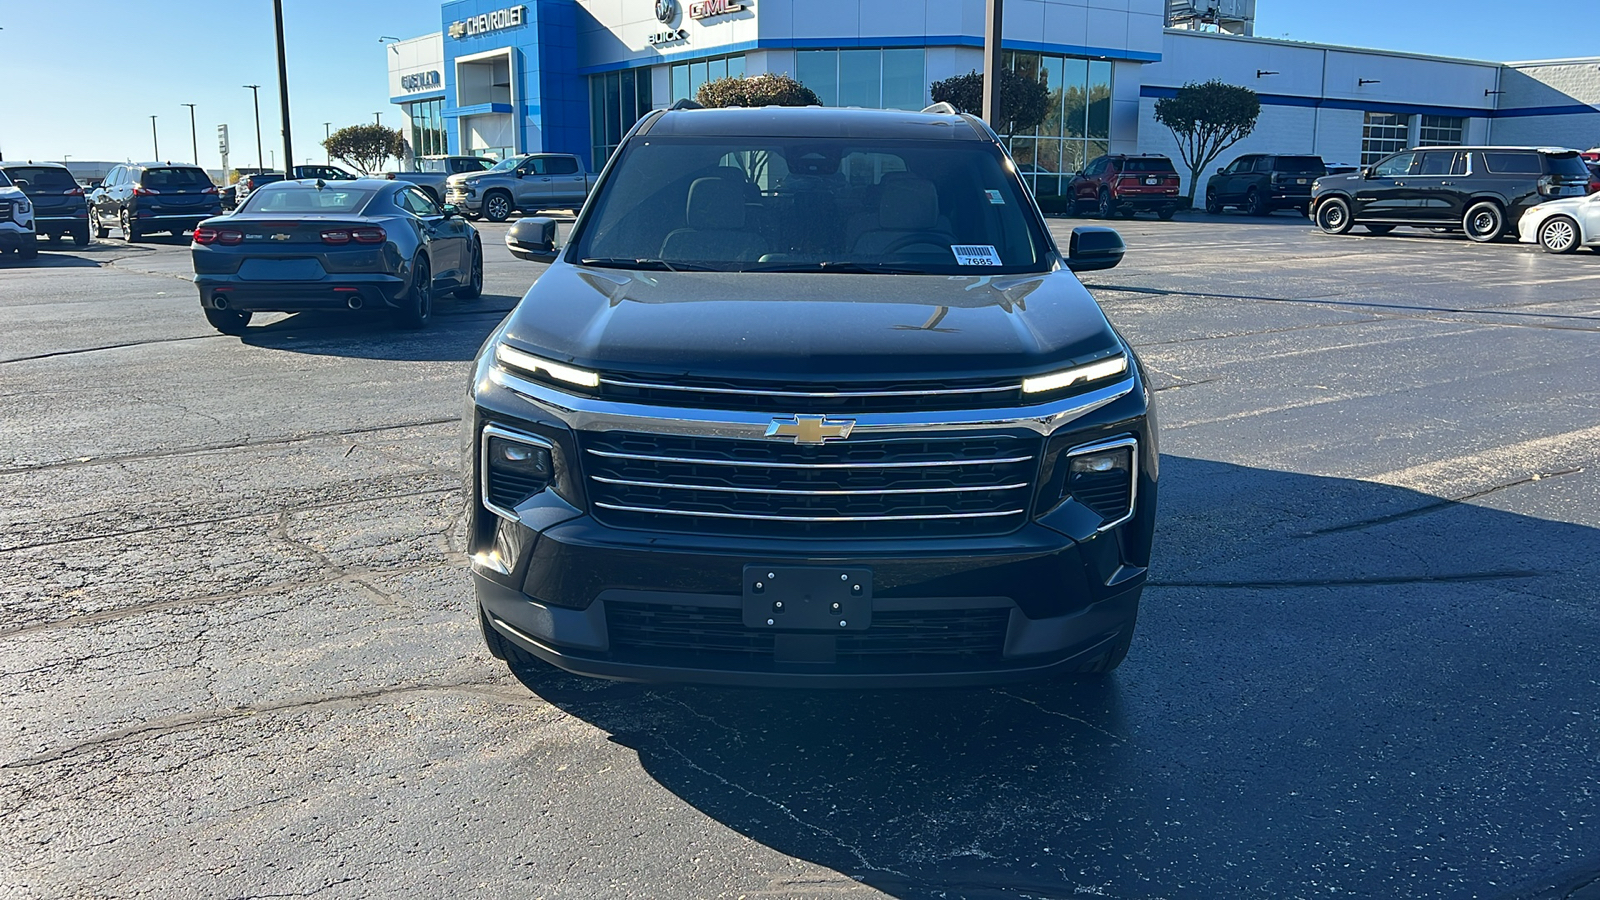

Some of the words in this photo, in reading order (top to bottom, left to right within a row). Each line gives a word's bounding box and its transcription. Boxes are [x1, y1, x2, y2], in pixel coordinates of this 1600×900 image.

[690, 0, 743, 20] GMC
[466, 5, 524, 35] CHEVROLET
[648, 29, 681, 44] BUICK
[965, 257, 993, 265] 7685
